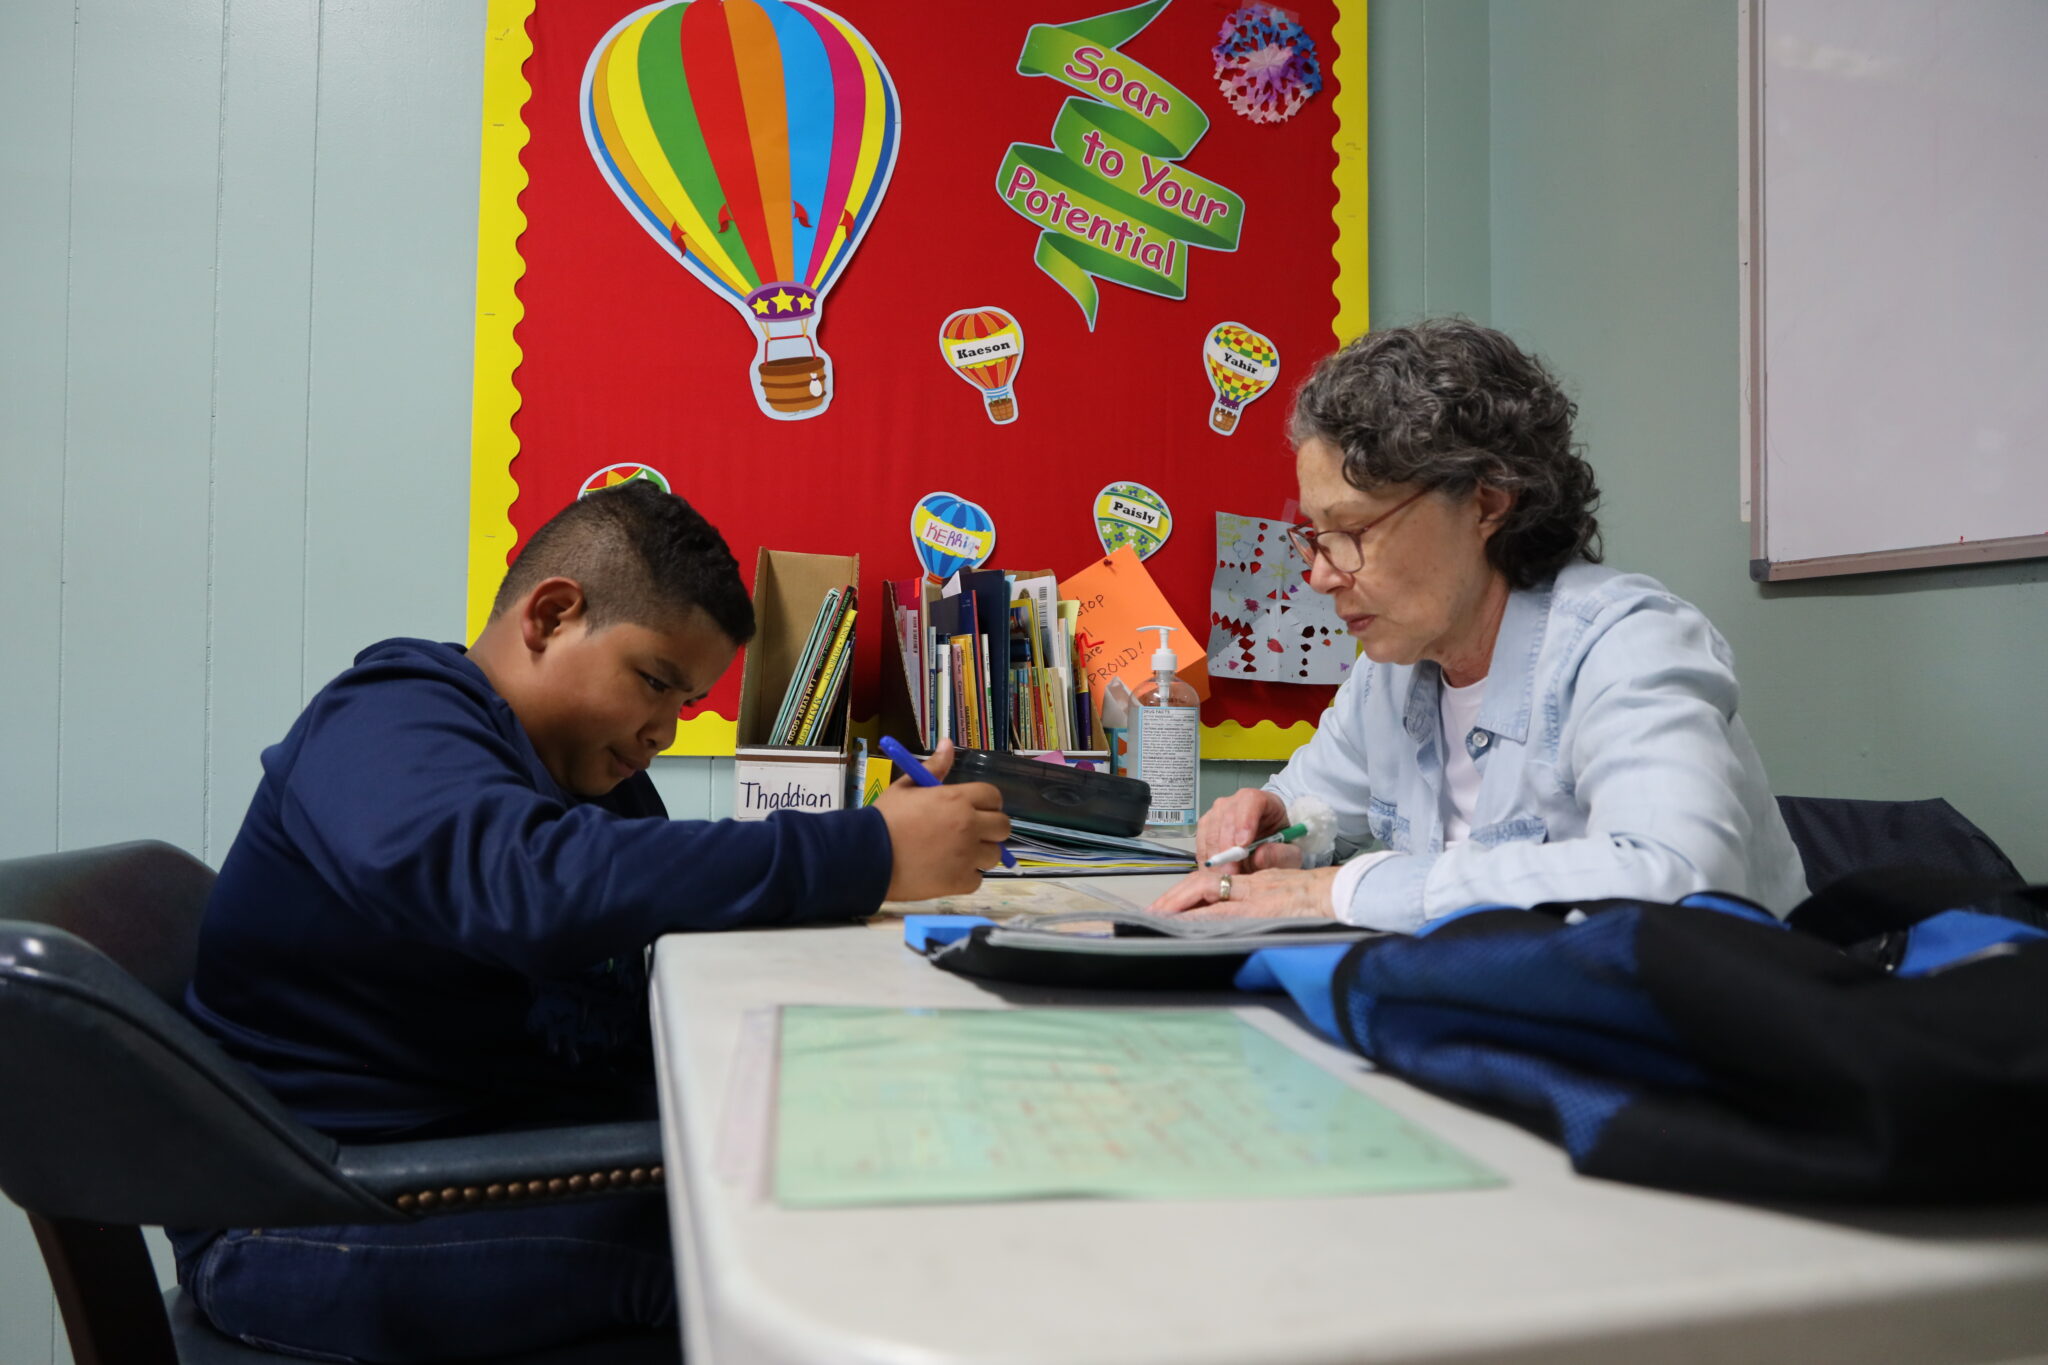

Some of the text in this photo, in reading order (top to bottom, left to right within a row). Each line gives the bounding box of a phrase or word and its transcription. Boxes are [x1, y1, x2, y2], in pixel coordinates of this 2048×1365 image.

[1064, 47, 1170, 118] Soar
[1083, 131, 1227, 226] to Your
[1005, 166, 1176, 276] Potential
[957, 342, 1011, 359] Kaeson
[1224, 352, 1258, 374] Yahir
[1113, 501, 1155, 524] Paisly
[1087, 640, 1144, 686] PROUD!
[806, 682, 815, 695] AM
[797, 695, 810, 718] EVERY
[788, 719, 801, 742] GOOD
[740, 782, 832, 810] Thaddian
